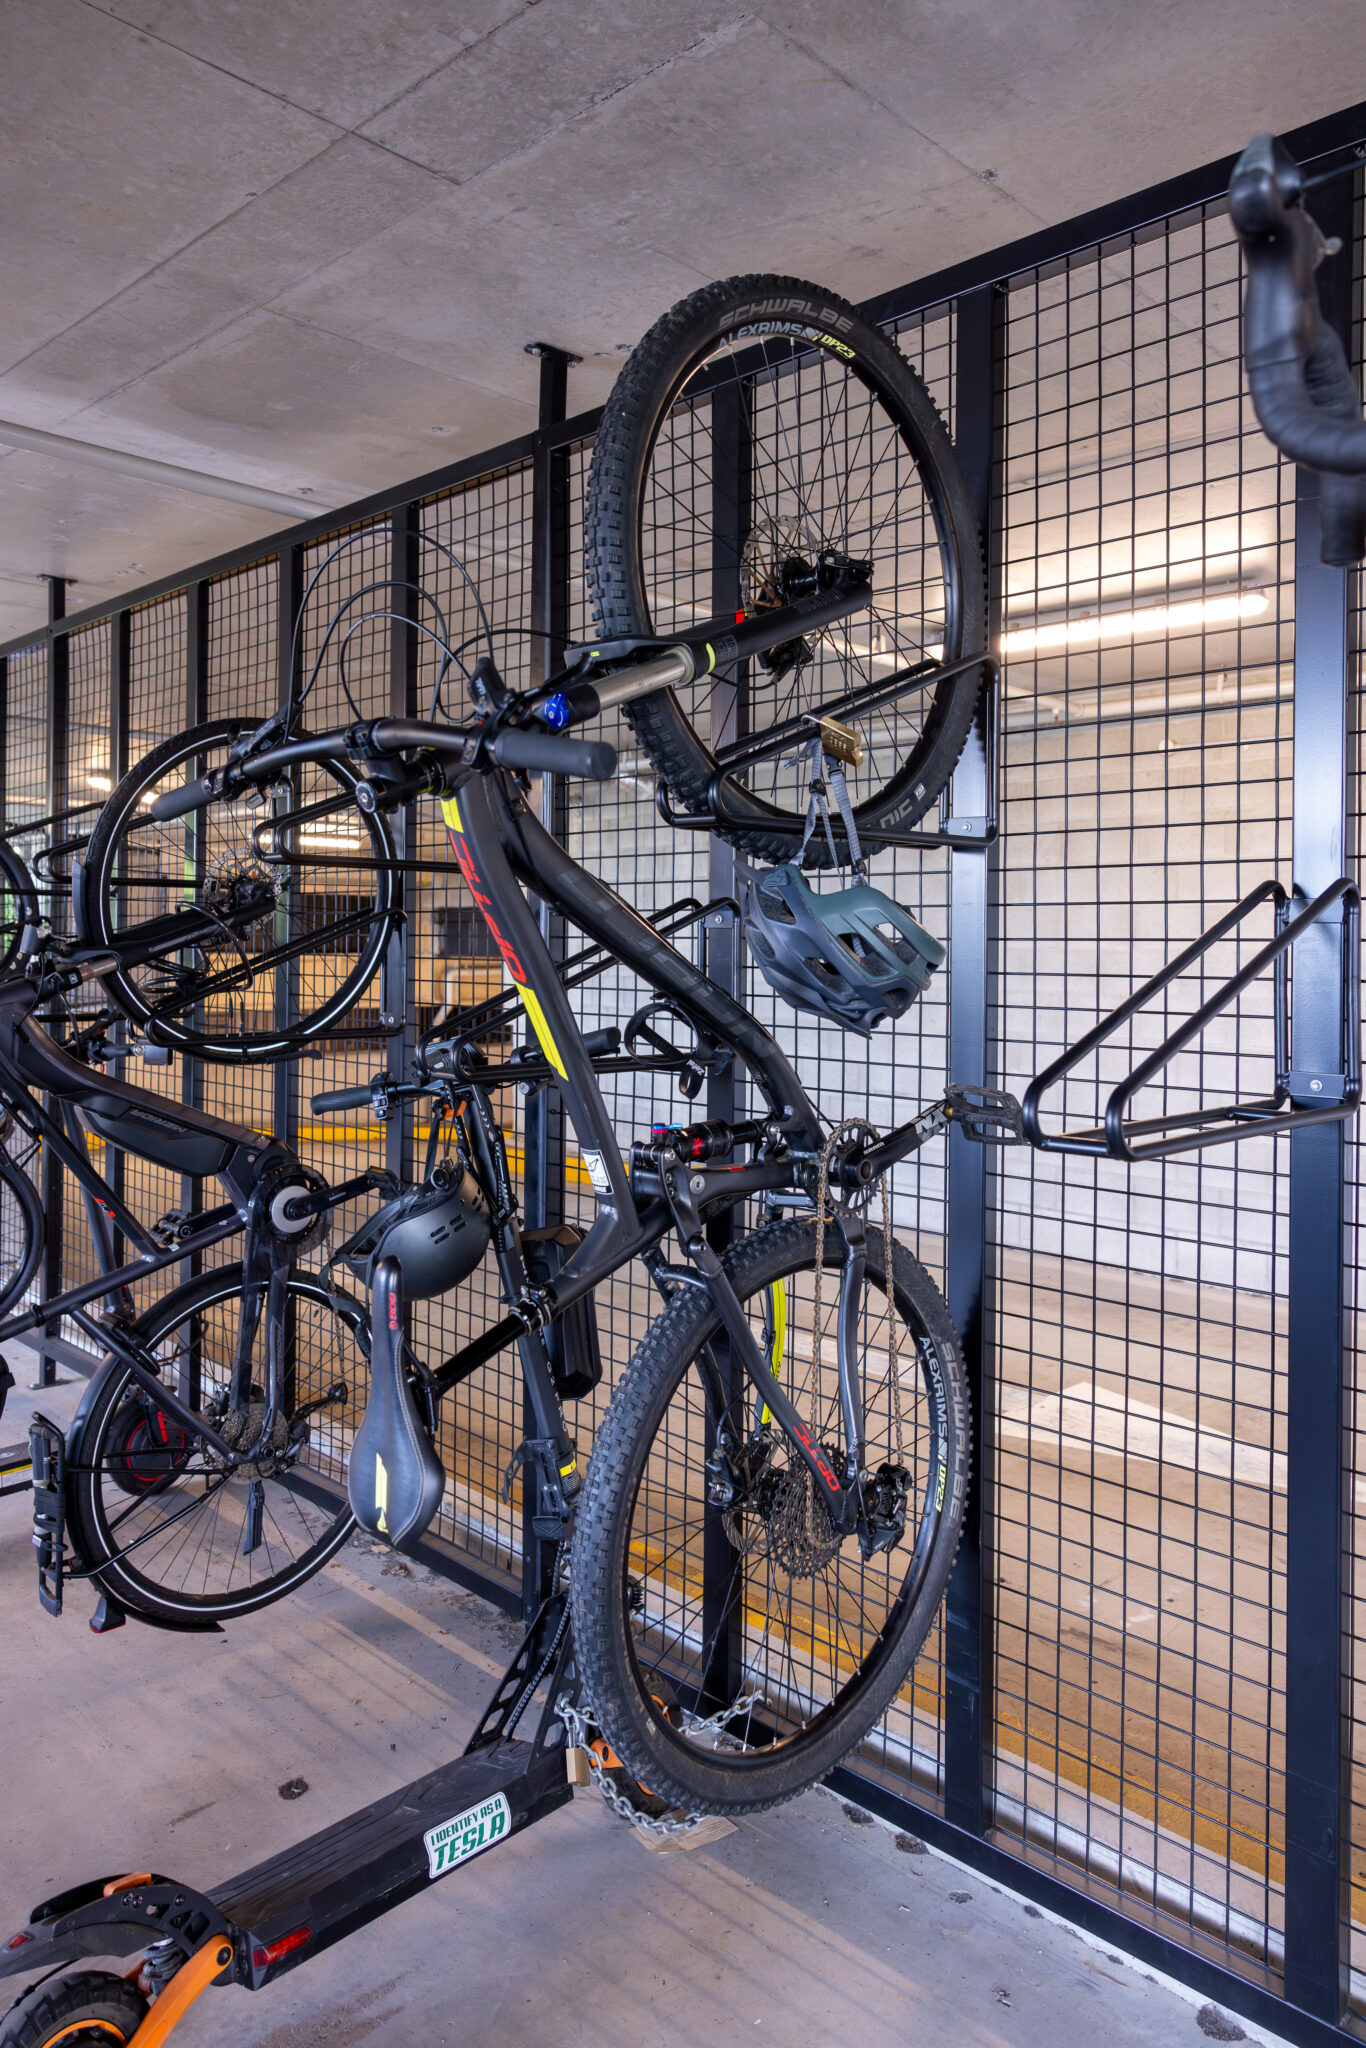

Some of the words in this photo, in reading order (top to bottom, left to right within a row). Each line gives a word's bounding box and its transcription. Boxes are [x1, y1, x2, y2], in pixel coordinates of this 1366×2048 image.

[718, 320, 803, 349] ALEXRIMS
[821, 334, 857, 359] DP23
[719, 298, 854, 334] SCHWALBE
[449, 830, 527, 984] OPTIC
[130, 1109, 188, 1133] MERIDA
[919, 1336, 948, 1439] ALEXRIMS
[935, 1464, 947, 1513] DP23
[941, 1342, 969, 1521] SCHWALBE
[793, 1422, 840, 1492] OPTIC
[430, 1834, 435, 1847] I
[436, 1810, 478, 1844] IDENTIFY
[480, 1802, 494, 1819] AS
[494, 1798, 502, 1811] A
[434, 1811, 505, 1871] TESLA
